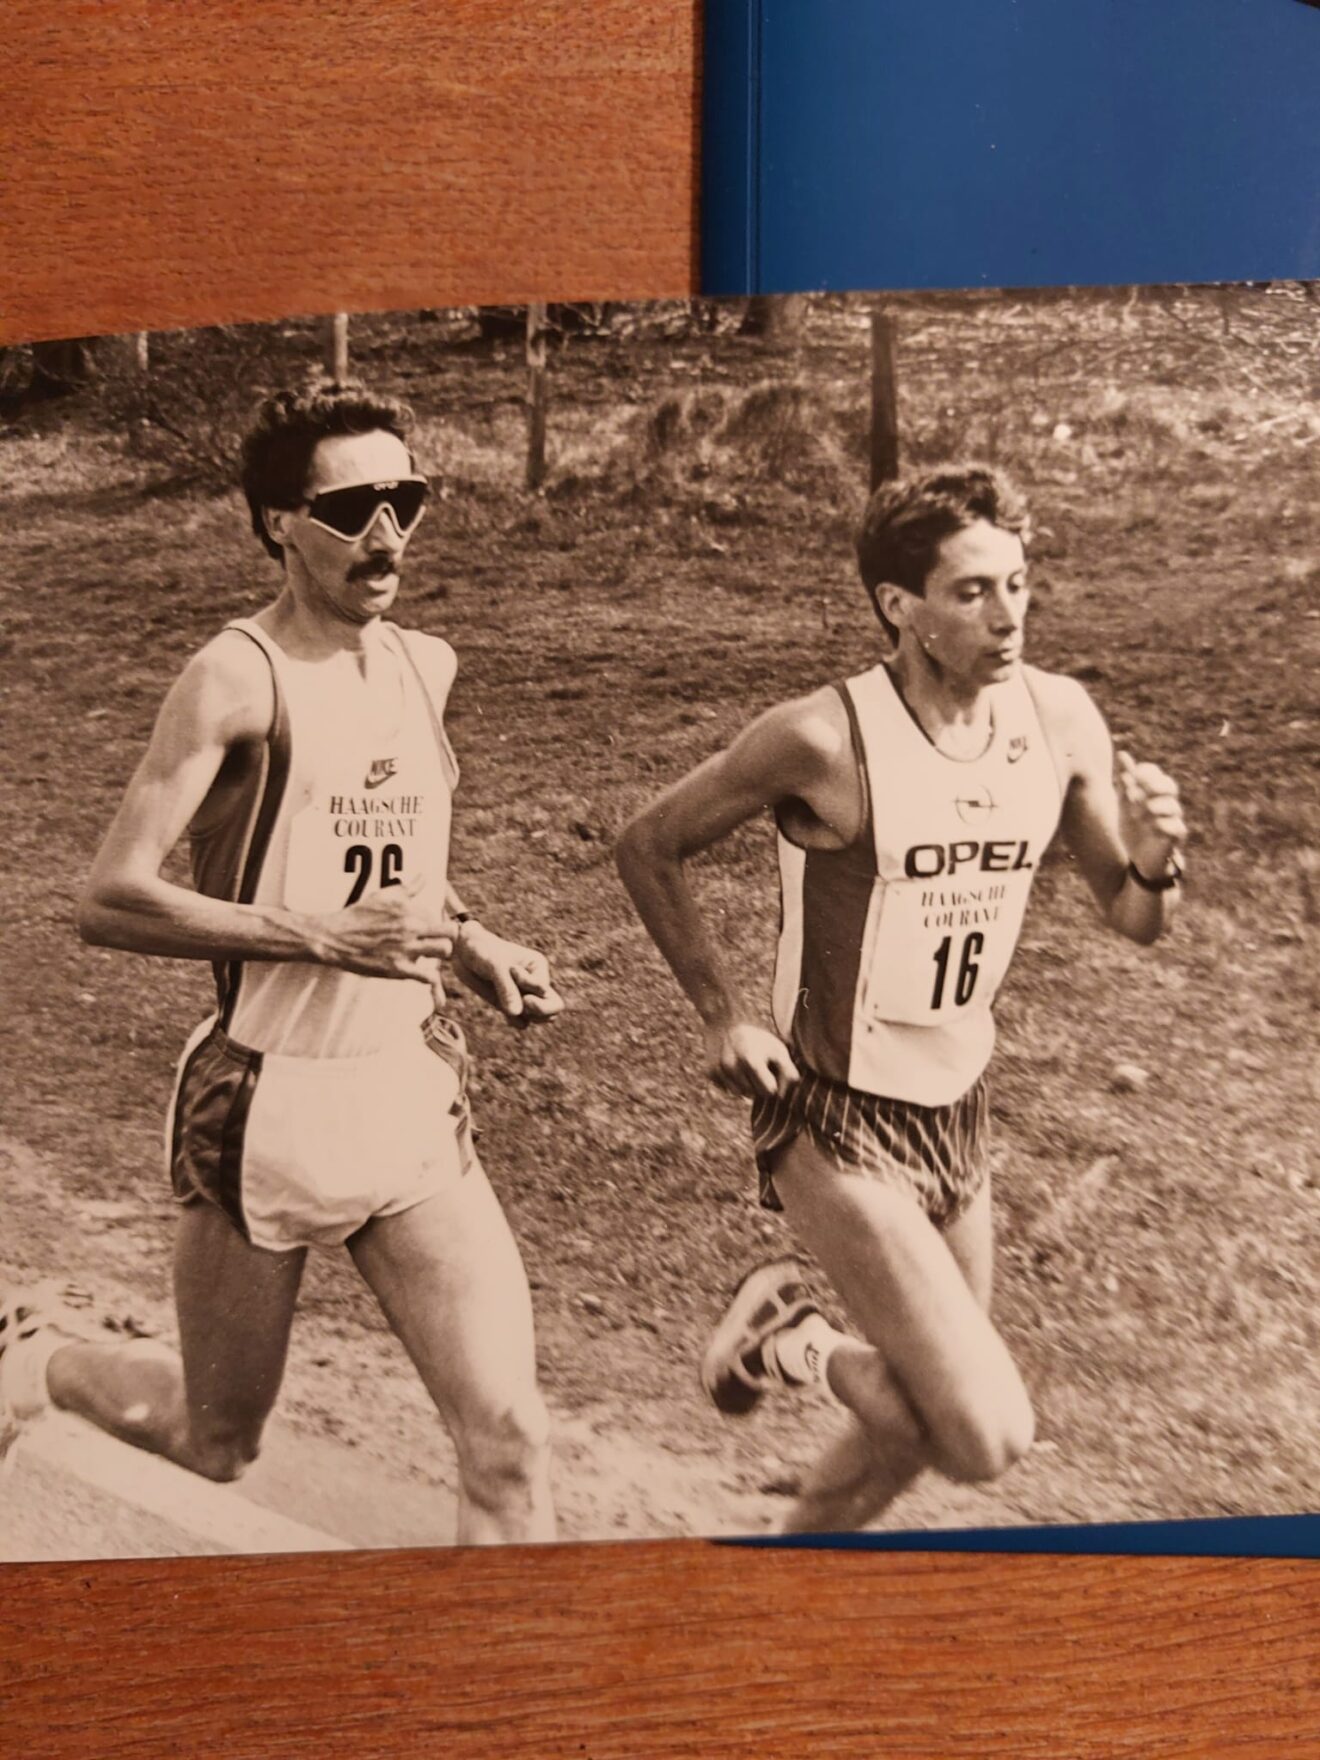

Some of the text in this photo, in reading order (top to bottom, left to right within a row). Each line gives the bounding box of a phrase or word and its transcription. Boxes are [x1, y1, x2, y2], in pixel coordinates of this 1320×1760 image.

[330, 796, 423, 815] HAAGSCHE
[334, 819, 415, 838] COURANT
[904, 841, 1033, 878] OPEL
[930, 932, 984, 1010] 16
